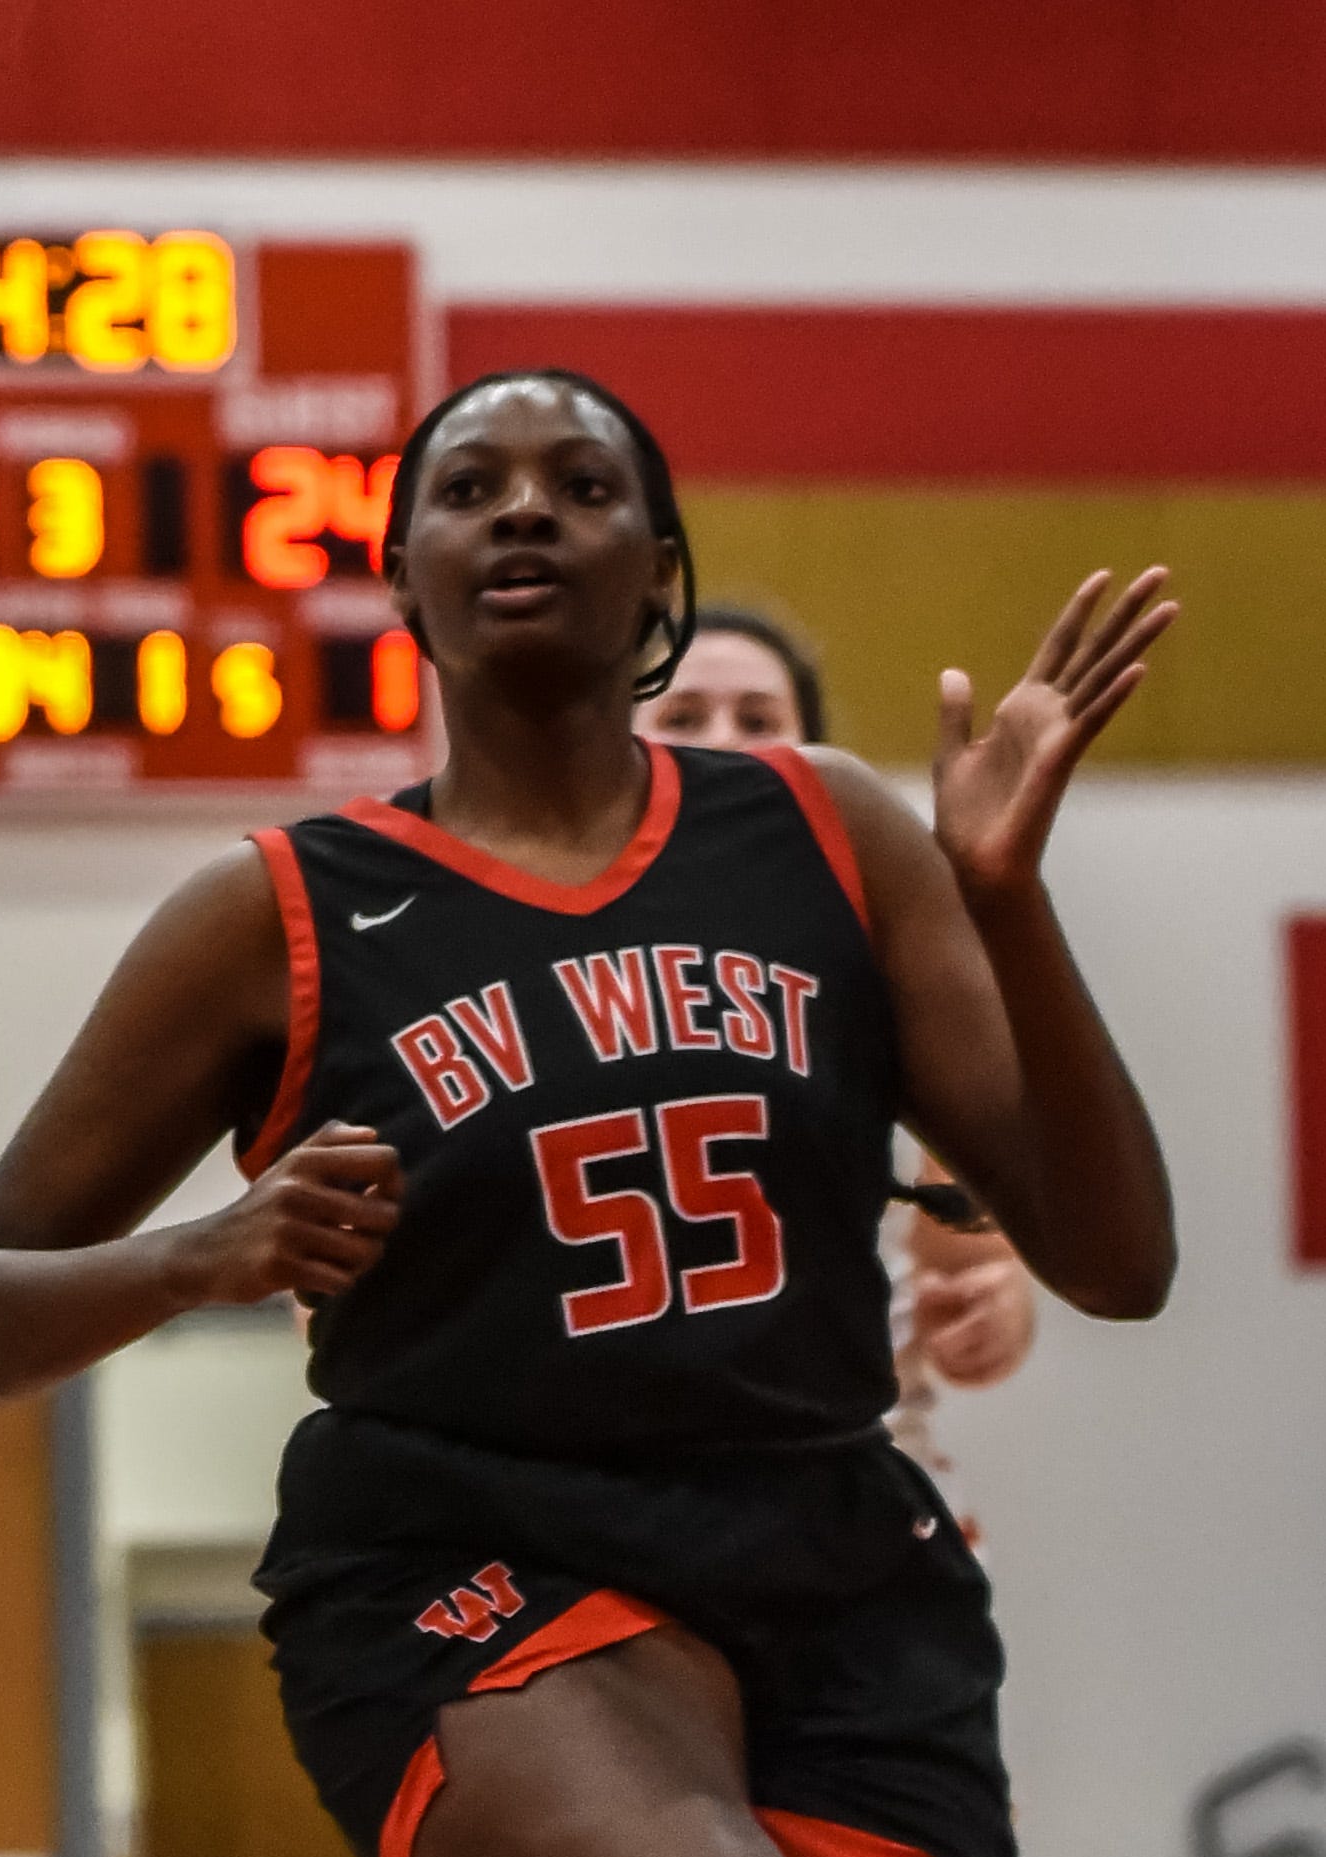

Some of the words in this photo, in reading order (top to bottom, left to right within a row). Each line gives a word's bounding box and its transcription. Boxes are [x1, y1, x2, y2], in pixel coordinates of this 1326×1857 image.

[26, 457, 104, 579] 3
[390, 980, 536, 1132] BV
[552, 944, 820, 1077] WEST
[529, 1094, 787, 1338] 55
[414, 1560, 527, 1644] W
